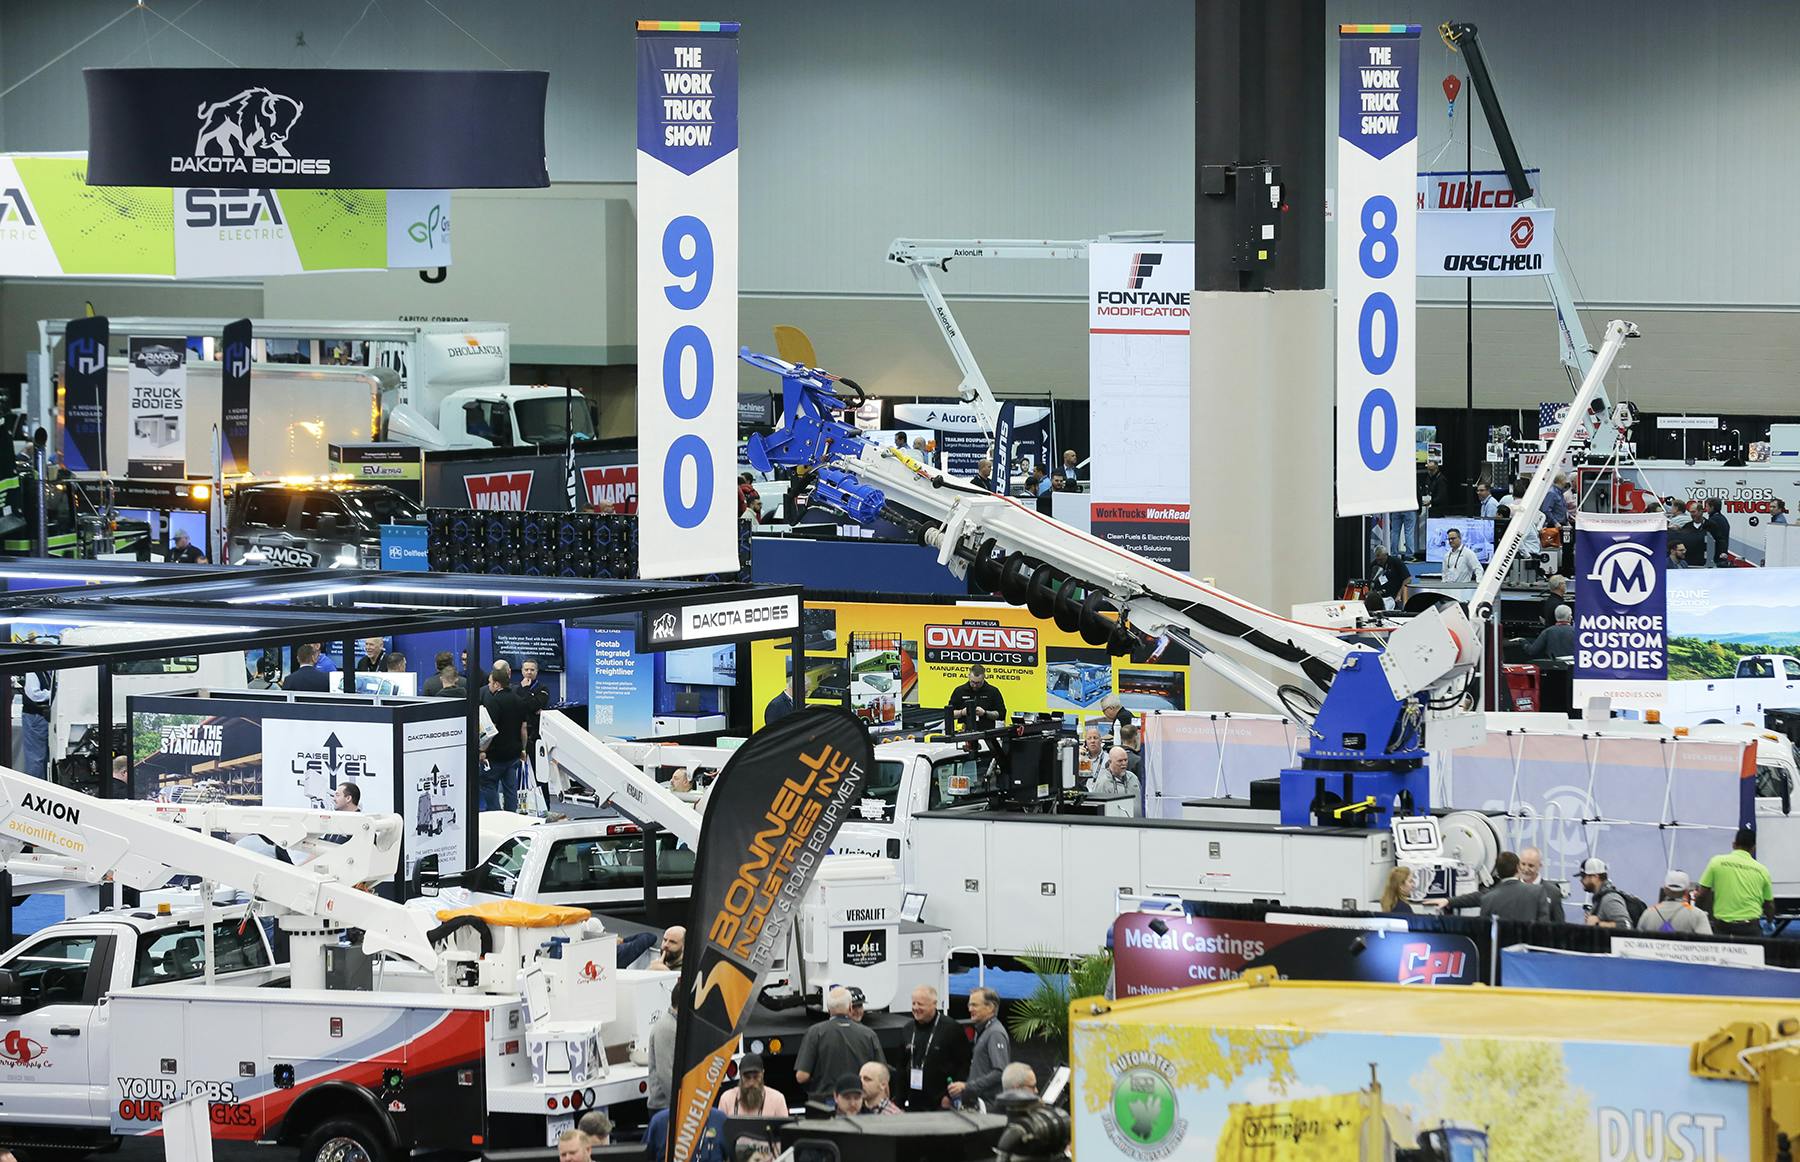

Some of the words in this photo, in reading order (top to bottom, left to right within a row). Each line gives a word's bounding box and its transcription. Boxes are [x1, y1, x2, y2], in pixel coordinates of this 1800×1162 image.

[674, 47, 702, 68] THE
[1369, 47, 1391, 65] THE
[664, 73, 712, 94] WORK
[1361, 70, 1399, 88] WORK
[664, 100, 712, 120] TRUCK
[1361, 93, 1399, 111] TRUCK
[171, 157, 247, 173] DAKOTA
[252, 158, 330, 174] BODIES
[1438, 180, 1534, 208] Wilco
[186, 188, 283, 227] SEA
[219, 228, 285, 240] ELECTRIC
[954, 249, 983, 257] AxionLift
[1098, 291, 1190, 305] FONTAINE
[137, 353, 179, 362] ARMOR
[134, 387, 181, 398] TRUCK
[132, 398, 183, 409] BODIES
[737, 402, 765, 412] achines
[942, 412, 977, 424] Aurora
[476, 490, 521, 511] WARN
[592, 482, 637, 506] WARN
[1685, 487, 1729, 500] YOUR
[249, 545, 313, 565] ARMOR
[692, 610, 742, 630] DAKOTA
[745, 605, 789, 623] BODIES
[1579, 615, 1663, 630] MONROE
[595, 640, 621, 648] Geotab
[927, 627, 1035, 650] OWENS
[1579, 632, 1663, 649] CUSTOM
[595, 649, 630, 658] Integrated
[595, 658, 624, 666] Solution
[624, 659, 635, 667] for
[940, 651, 1022, 664] PRODUCTS
[1578, 651, 1663, 669] BODIES
[595, 667, 635, 677] Freightliner
[993, 667, 1034, 675] SOLUTIONS
[179, 724, 201, 739] SET
[202, 725, 223, 740] THE
[407, 729, 464, 742] DAKOTABODIES.COM
[160, 738, 222, 757] STANDARD
[297, 752, 329, 761] RAISE
[337, 753, 367, 761] YOUR
[291, 759, 376, 777] LEVEL
[416, 779, 455, 792] LEVEL
[21, 792, 80, 825] AXION
[808, 761, 865, 853] EQUIPMENT
[9, 818, 85, 853] axionlift.com
[709, 744, 833, 950] BONNELL
[733, 798, 823, 960] INDUSTRIES
[815, 751, 851, 798] INC
[784, 850, 816, 899] ROAD
[778, 898, 792, 914] &
[846, 908, 885, 921] VERSALIFT
[752, 914, 786, 967] TRUCK
[1125, 927, 1178, 950] Metal
[1182, 932, 1265, 961] Castings
[1189, 964, 1217, 979] CNC
[1111, 1050, 1177, 1078] AUTOMATED
[118, 1077, 176, 1100] YOUR
[119, 1100, 163, 1121] OUR
[673, 1055, 726, 1162] ONNELL.COM
[1598, 1106, 1726, 1162] DUST
